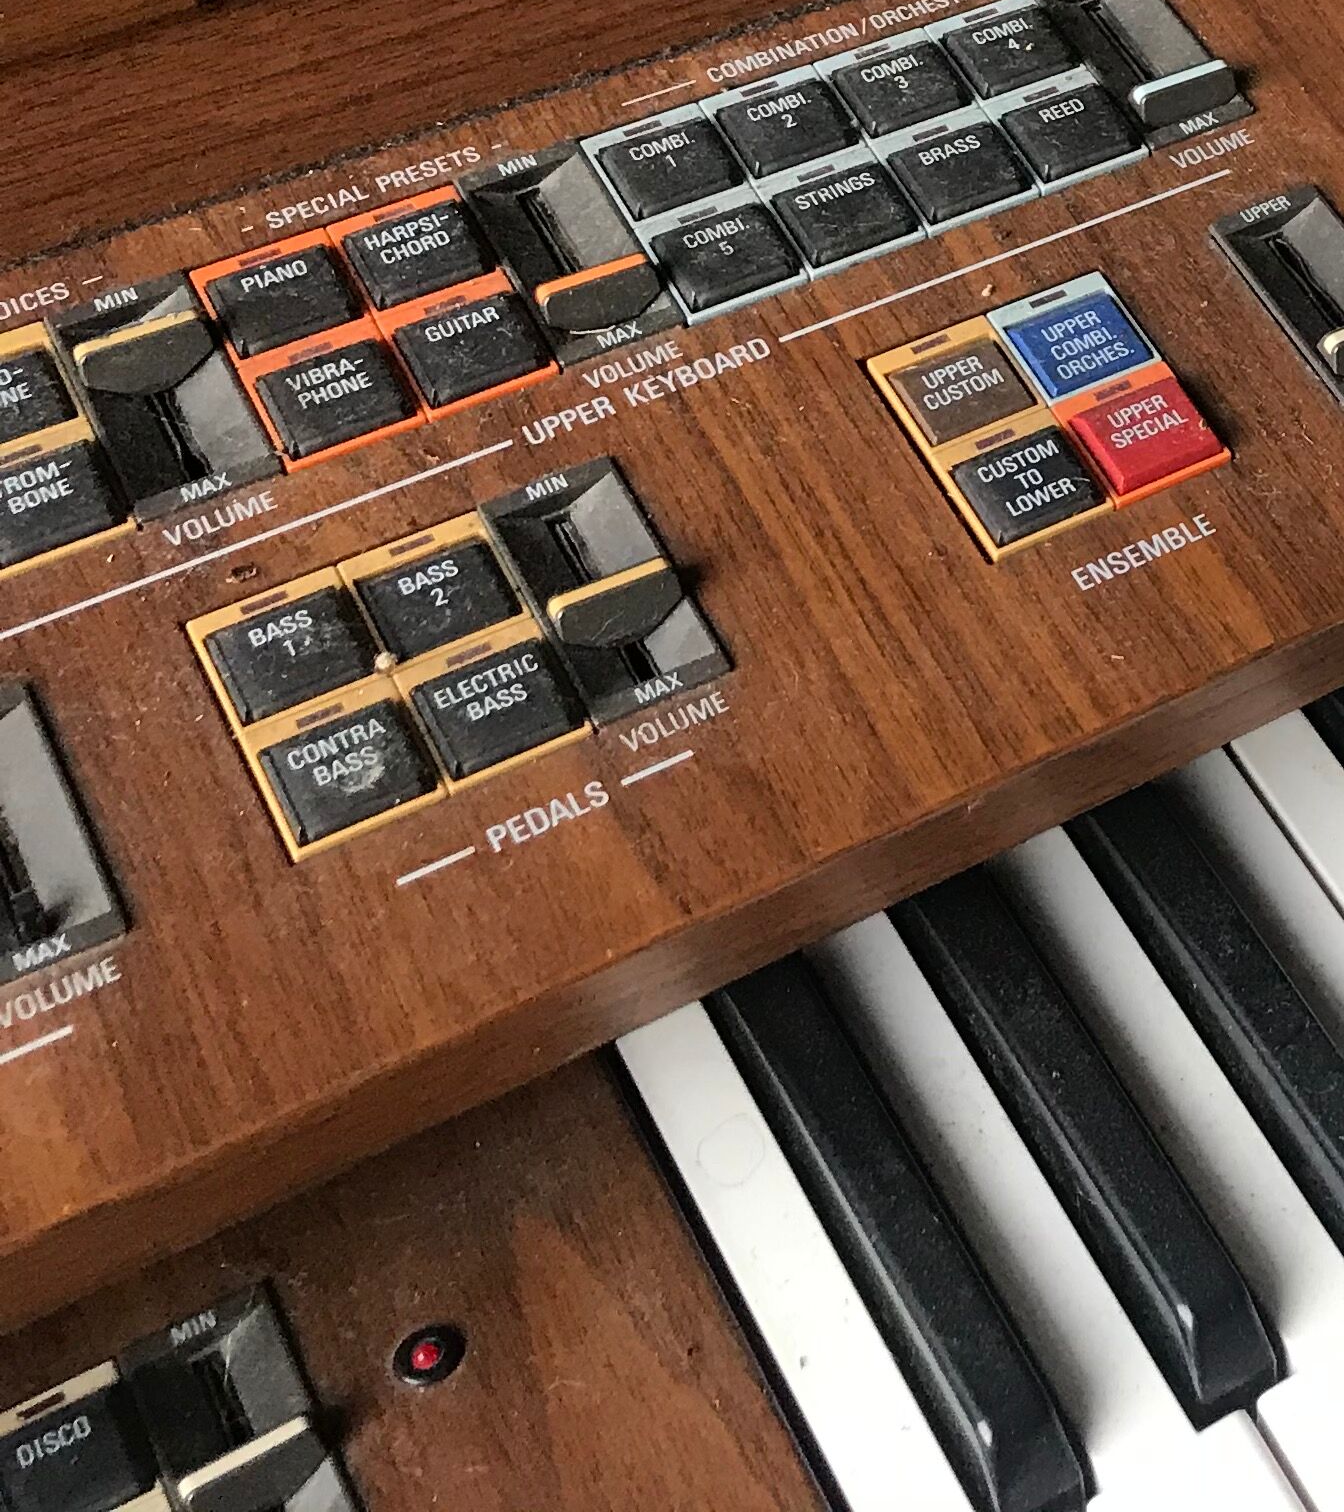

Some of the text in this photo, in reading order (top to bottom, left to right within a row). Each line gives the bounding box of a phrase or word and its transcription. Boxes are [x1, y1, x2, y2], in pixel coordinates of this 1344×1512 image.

[971, 17, 1032, 47] COMBI.
[1007, 36, 1020, 52] 4
[861, 54, 923, 85] COMBI.
[893, 73, 908, 90] 3
[747, 92, 811, 124] COMBI.
[784, 112, 798, 129] 2
[1038, 97, 1085, 124] REED
[1178, 110, 1219, 137] MAX
[499, 151, 538, 178] MIN
[629, 131, 694, 163] COMBI.
[668, 153, 678, 170] 1
[919, 132, 981, 166] BRASS
[1169, 128, 1255, 170] VOLUME
[265, 146, 482, 231] SPECIAL PRESETS
[795, 171, 875, 210] STRINGS
[1238, 195, 1292, 224] UPPER
[364, 210, 449, 251] HARPSI-
[380, 229, 451, 266] CHORD
[683, 216, 749, 251] COMBI.
[718, 239, 734, 258] 5
[240, 259, 307, 292] PIANO
[93, 287, 138, 313] MIN
[424, 304, 500, 344] GUITAR
[597, 320, 643, 349] MAX
[1040, 309, 1102, 344] UPPER
[1049, 327, 1117, 360] COMBI.
[1056, 342, 1136, 382] ORCHES.
[285, 355, 363, 392] VIBRA-
[582, 340, 683, 389] VOLUME
[919, 354, 983, 391] UPPER
[298, 371, 372, 409] PHONE
[522, 335, 772, 446] UPPER KEYBOARD
[922, 367, 1005, 412] CUSTOM
[1106, 392, 1169, 430] UPPER
[1110, 408, 1189, 449] SPECIAL
[0, 460, 73, 499] ROM-
[976, 438, 1059, 484] CUSTOM
[7, 477, 74, 515] BONE
[180, 472, 232, 503] MAX
[525, 473, 569, 501] MIN
[1005, 476, 1077, 517] LOWER
[1018, 469, 1046, 491] TO
[162, 489, 279, 547] VOLUME
[1070, 512, 1217, 591] ENSEMBLE
[398, 559, 459, 597] BASS
[433, 585, 451, 608] 2
[247, 609, 313, 647] BASS
[281, 638, 296, 658] 1
[433, 653, 540, 711] ELECTRIC
[633, 672, 683, 705] MAX
[466, 682, 528, 721] BASS
[619, 691, 731, 753] VOLUME
[286, 718, 386, 770] CONTRA
[312, 745, 379, 785] BASS
[485, 780, 610, 853] PEDALS
[12, 933, 71, 971] MAX
[170, 1309, 217, 1347] MIN
[15, 1415, 92, 1469] DISCO
